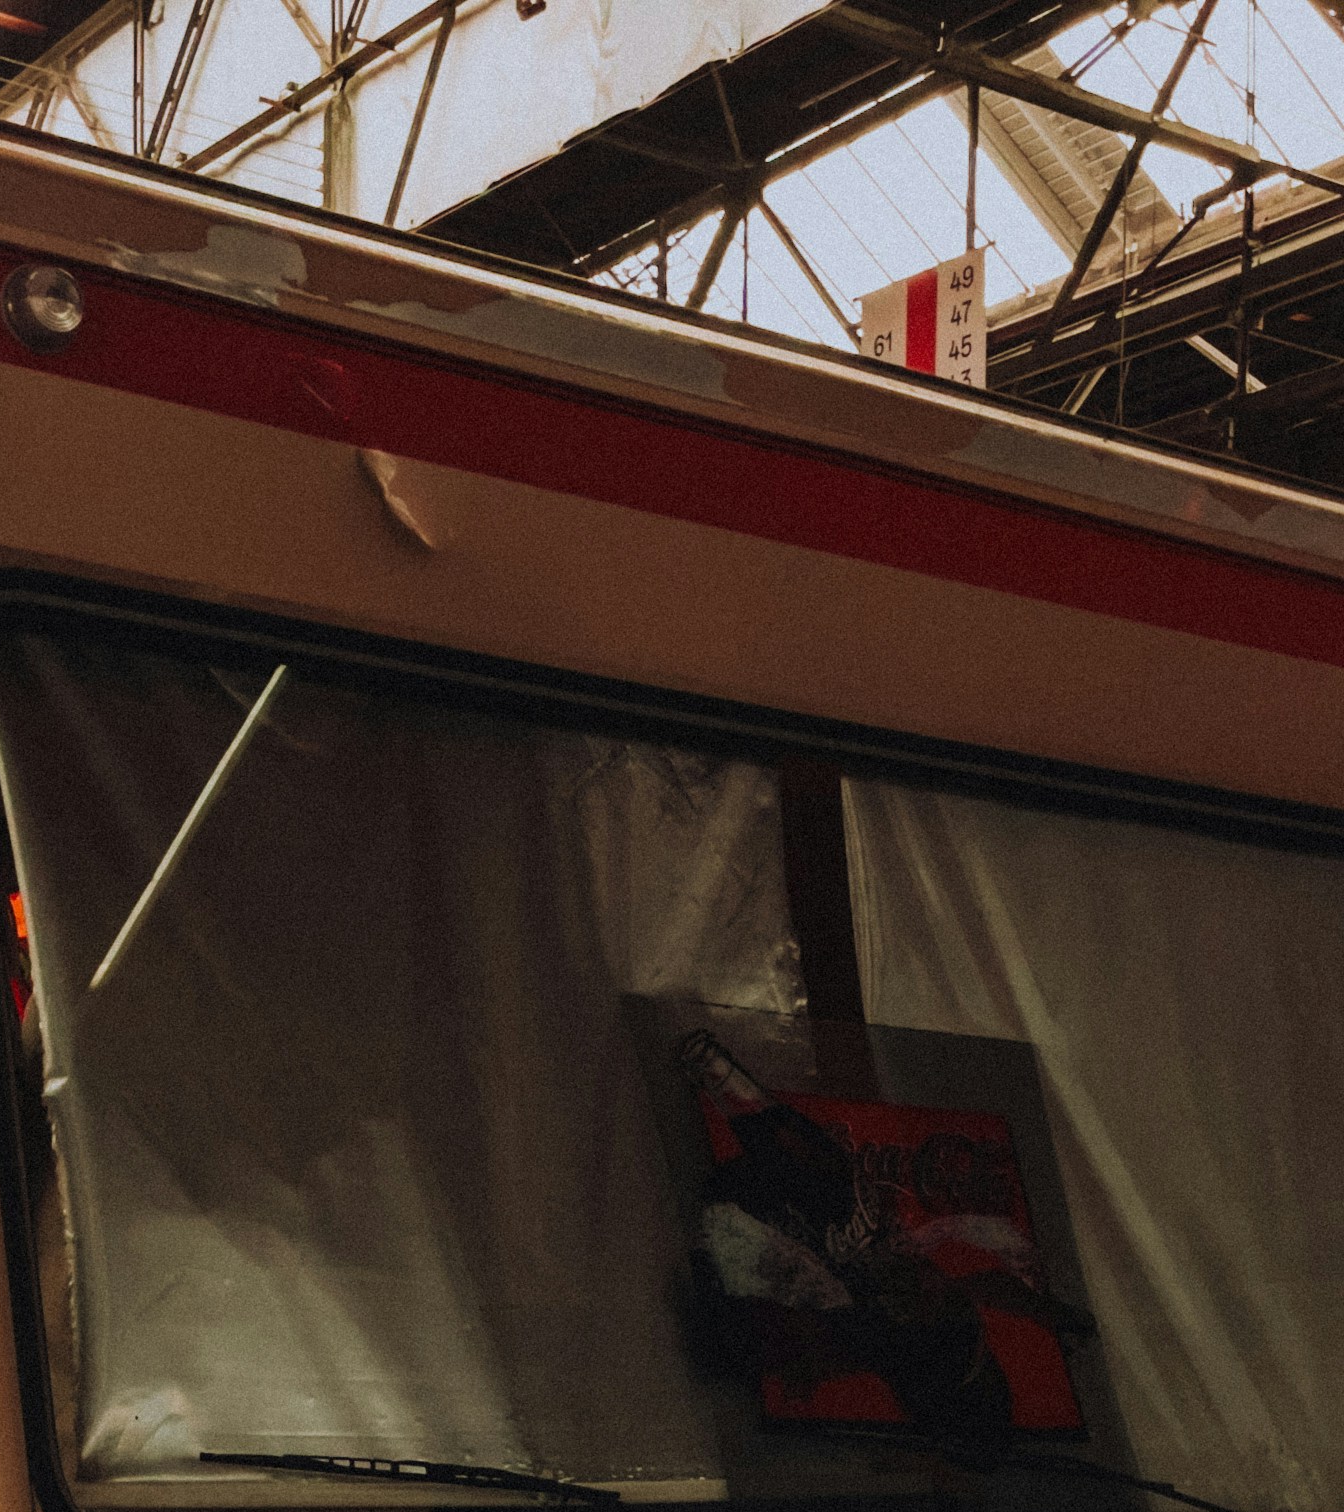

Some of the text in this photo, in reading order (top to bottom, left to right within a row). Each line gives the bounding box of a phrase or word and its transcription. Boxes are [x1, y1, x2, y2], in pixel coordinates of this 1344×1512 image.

[950, 265, 974, 292] 49
[950, 299, 972, 326] 47
[873, 330, 892, 357] 61
[948, 333, 972, 360] 45
[951, 368, 972, 386] 3
